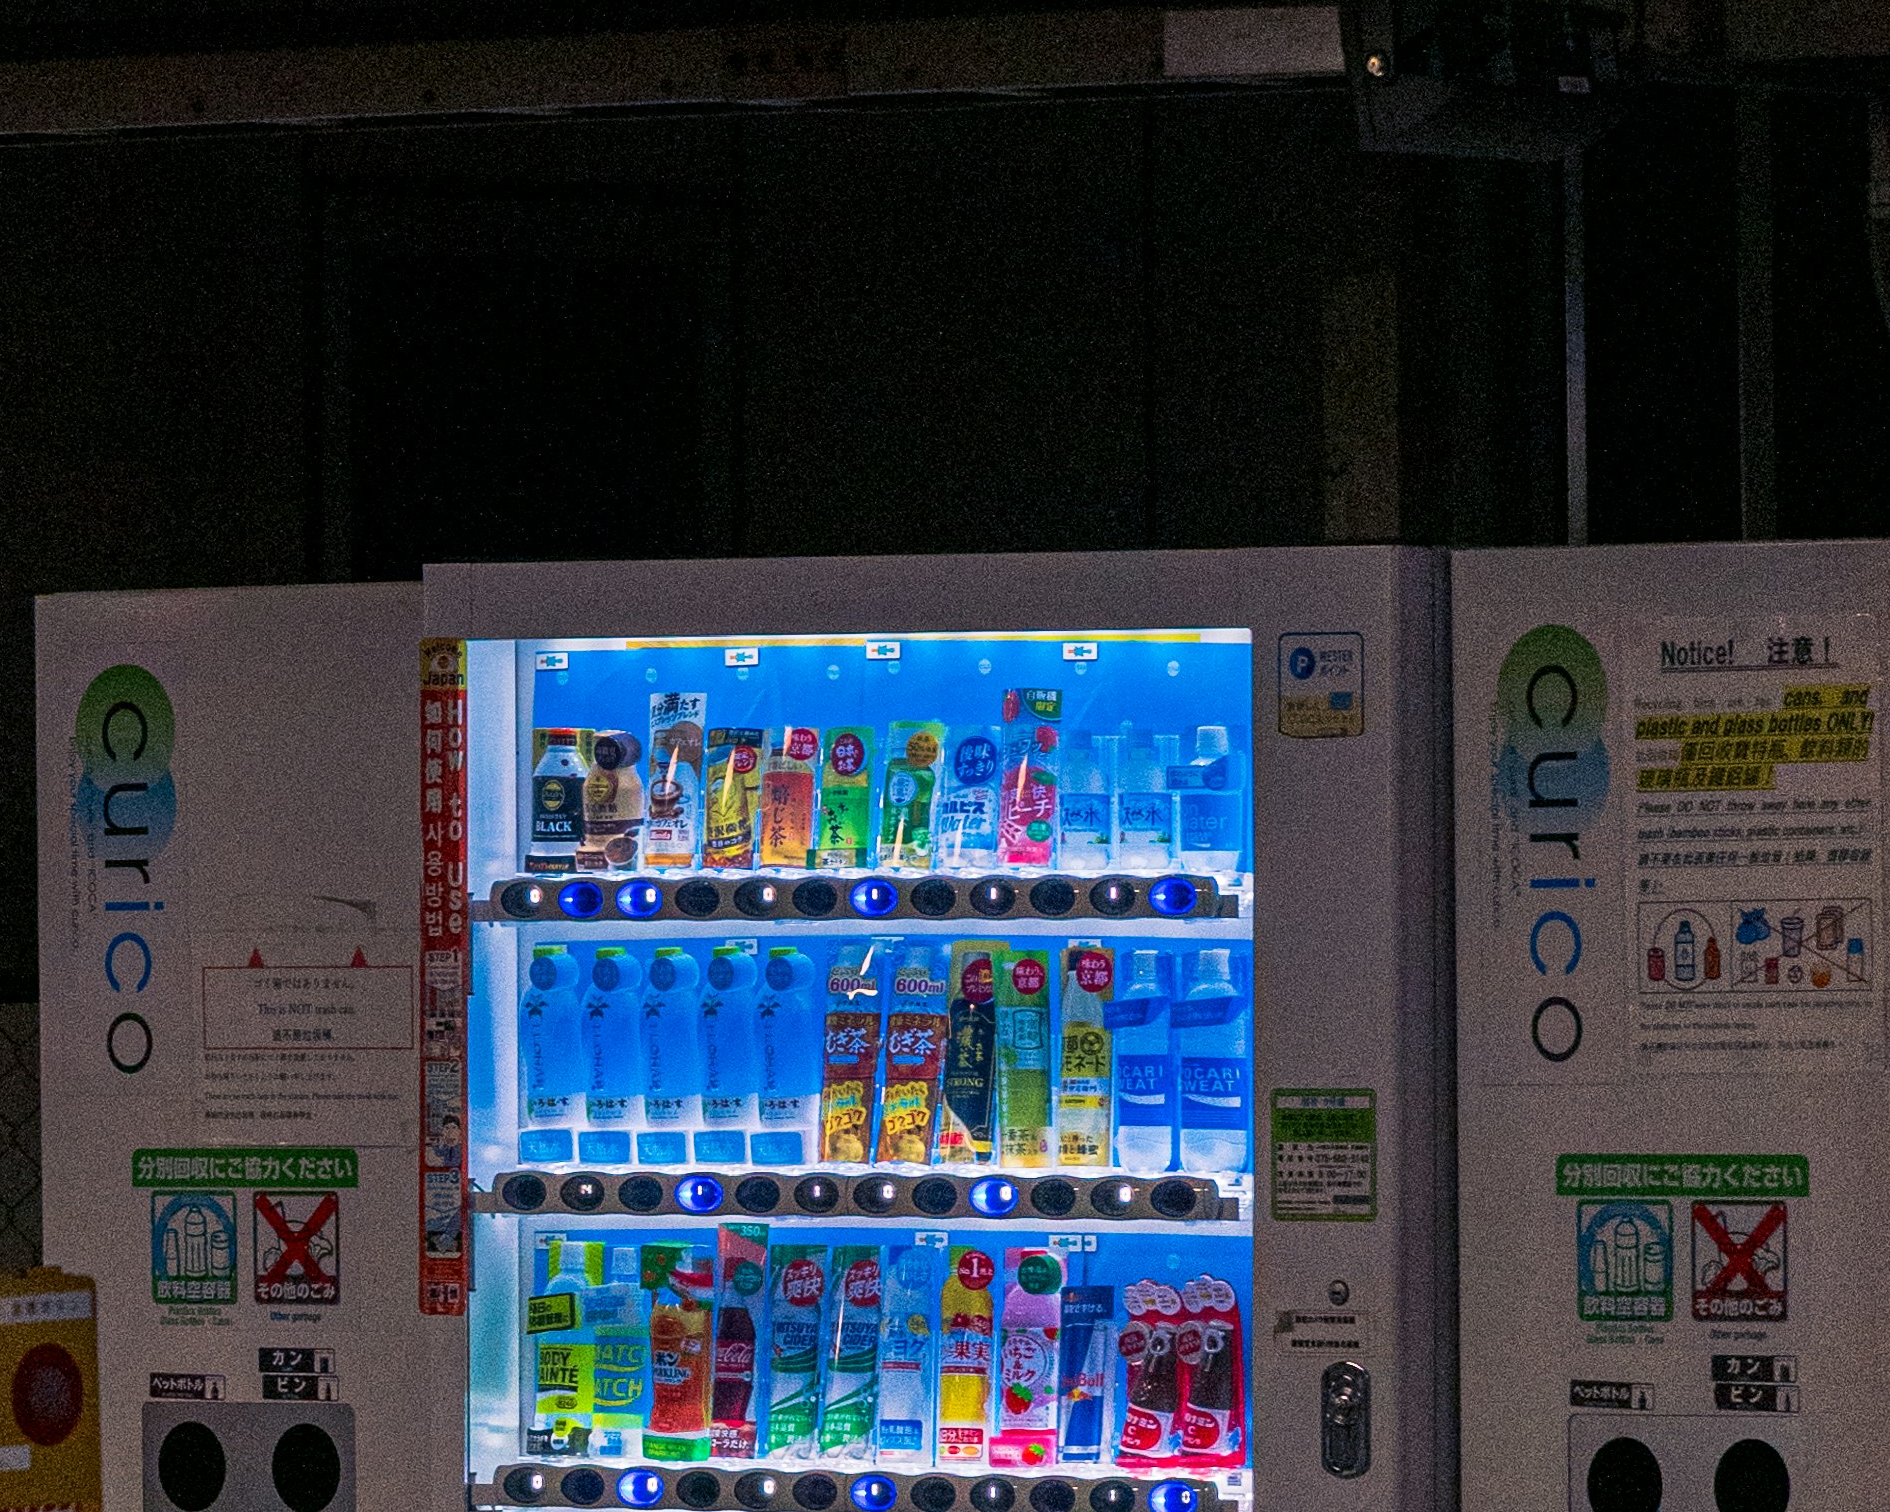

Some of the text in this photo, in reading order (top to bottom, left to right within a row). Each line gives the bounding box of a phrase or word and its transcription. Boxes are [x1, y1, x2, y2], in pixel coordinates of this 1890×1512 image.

[1661, 640, 1734, 666] Notice!
[424, 672, 464, 686] Japan
[1840, 689, 1869, 705] and
[1636, 711, 1874, 737] plastic and glass bottles ONLY!
[957, 761, 994, 777] すっきり
[536, 821, 573, 833] BLACK
[1527, 665, 1595, 1062] curico
[102, 701, 164, 1075] curico
[426, 821, 445, 938] 사용방법
[447, 862, 463, 934] use
[895, 977, 944, 994] 600ml
[826, 1028, 870, 1054] むぎ茶
[888, 1028, 937, 1055] むぎ茶
[138, 1156, 353, 1181] 分別回収にご協力ください
[1562, 1162, 1805, 1191] 分別回収にご協力ください
[785, 1265, 817, 1282] スッキリ
[157, 1281, 336, 1300] 飲料空容器 その他のごみ
[787, 1281, 821, 1299] 爽快
[1695, 1298, 1784, 1317] その他のごみ
[272, 1351, 302, 1366] カン
[955, 1341, 990, 1359] 果実
[1004, 1345, 1036, 1363] いちご
[1727, 1358, 1761, 1374] カン
[151, 1378, 203, 1391] ペットボトル
[277, 1378, 306, 1392] ビン
[1005, 1368, 1036, 1385] ミルク
[1079, 1373, 1104, 1386] Bull
